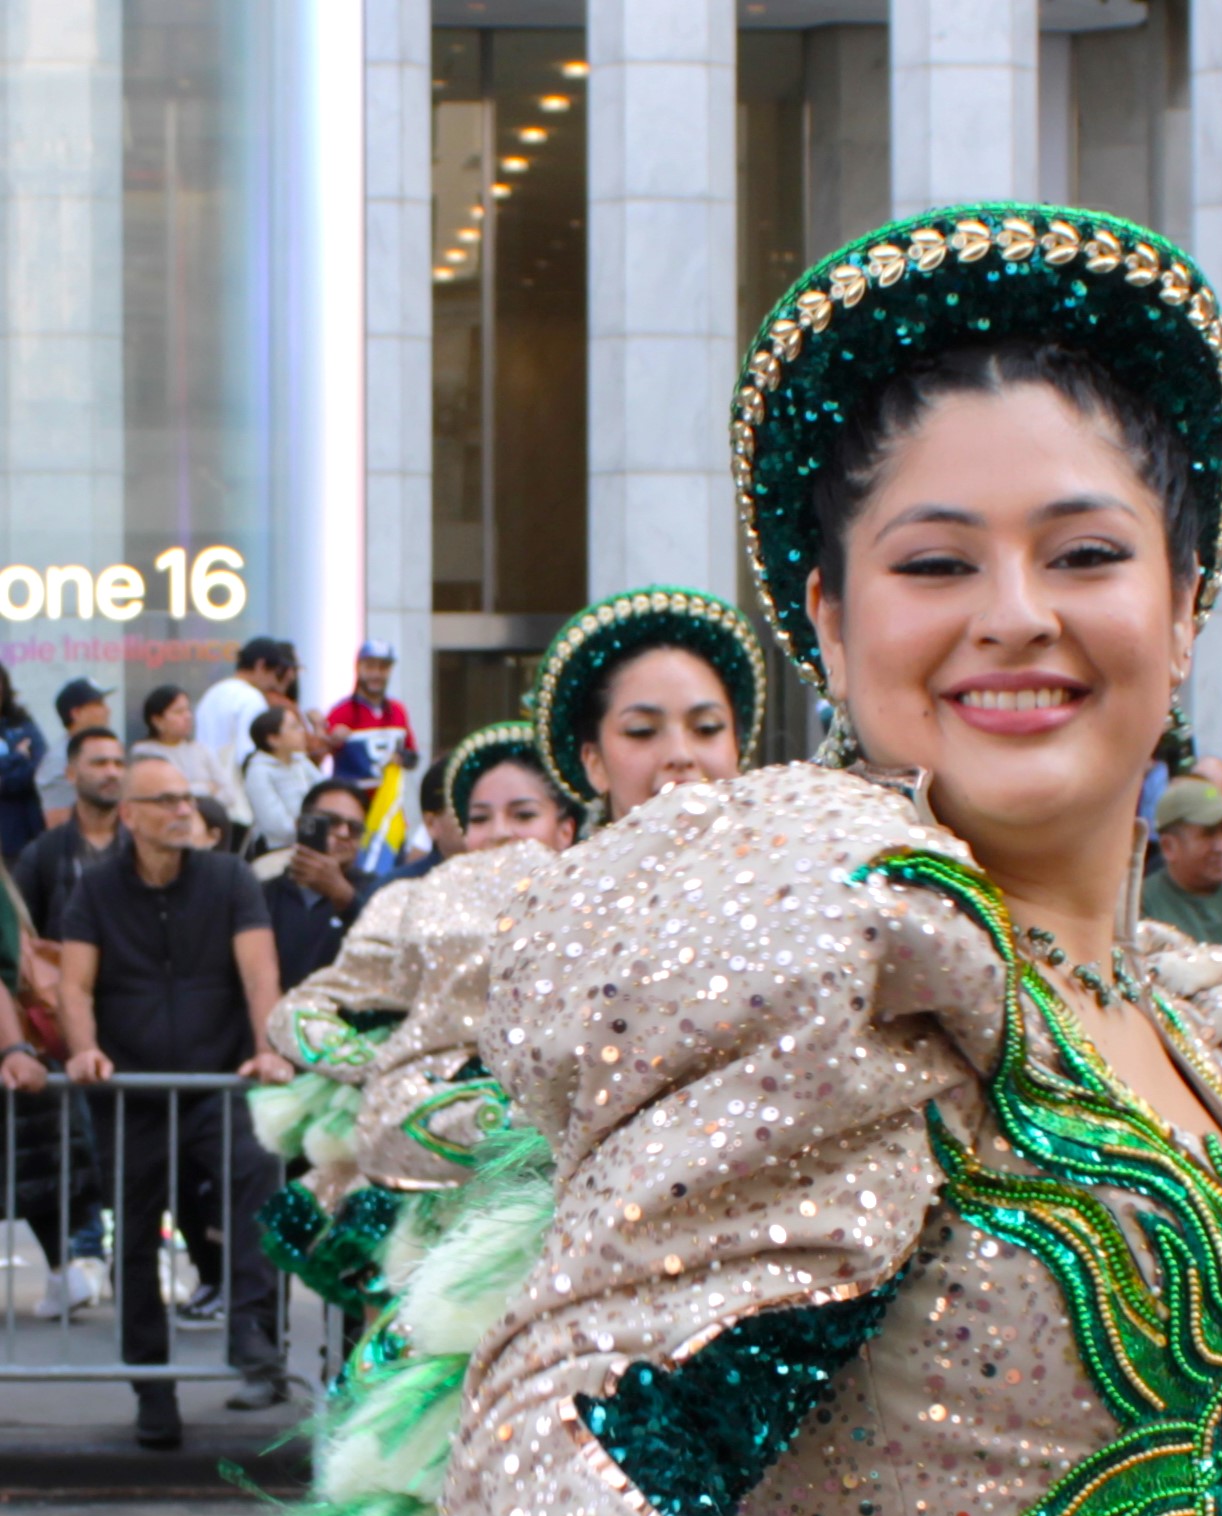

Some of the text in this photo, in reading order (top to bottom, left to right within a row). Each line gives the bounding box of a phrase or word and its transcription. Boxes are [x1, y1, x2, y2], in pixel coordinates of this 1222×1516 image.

[0, 545, 247, 621] one 16
[62, 633, 239, 670] Intelligence
